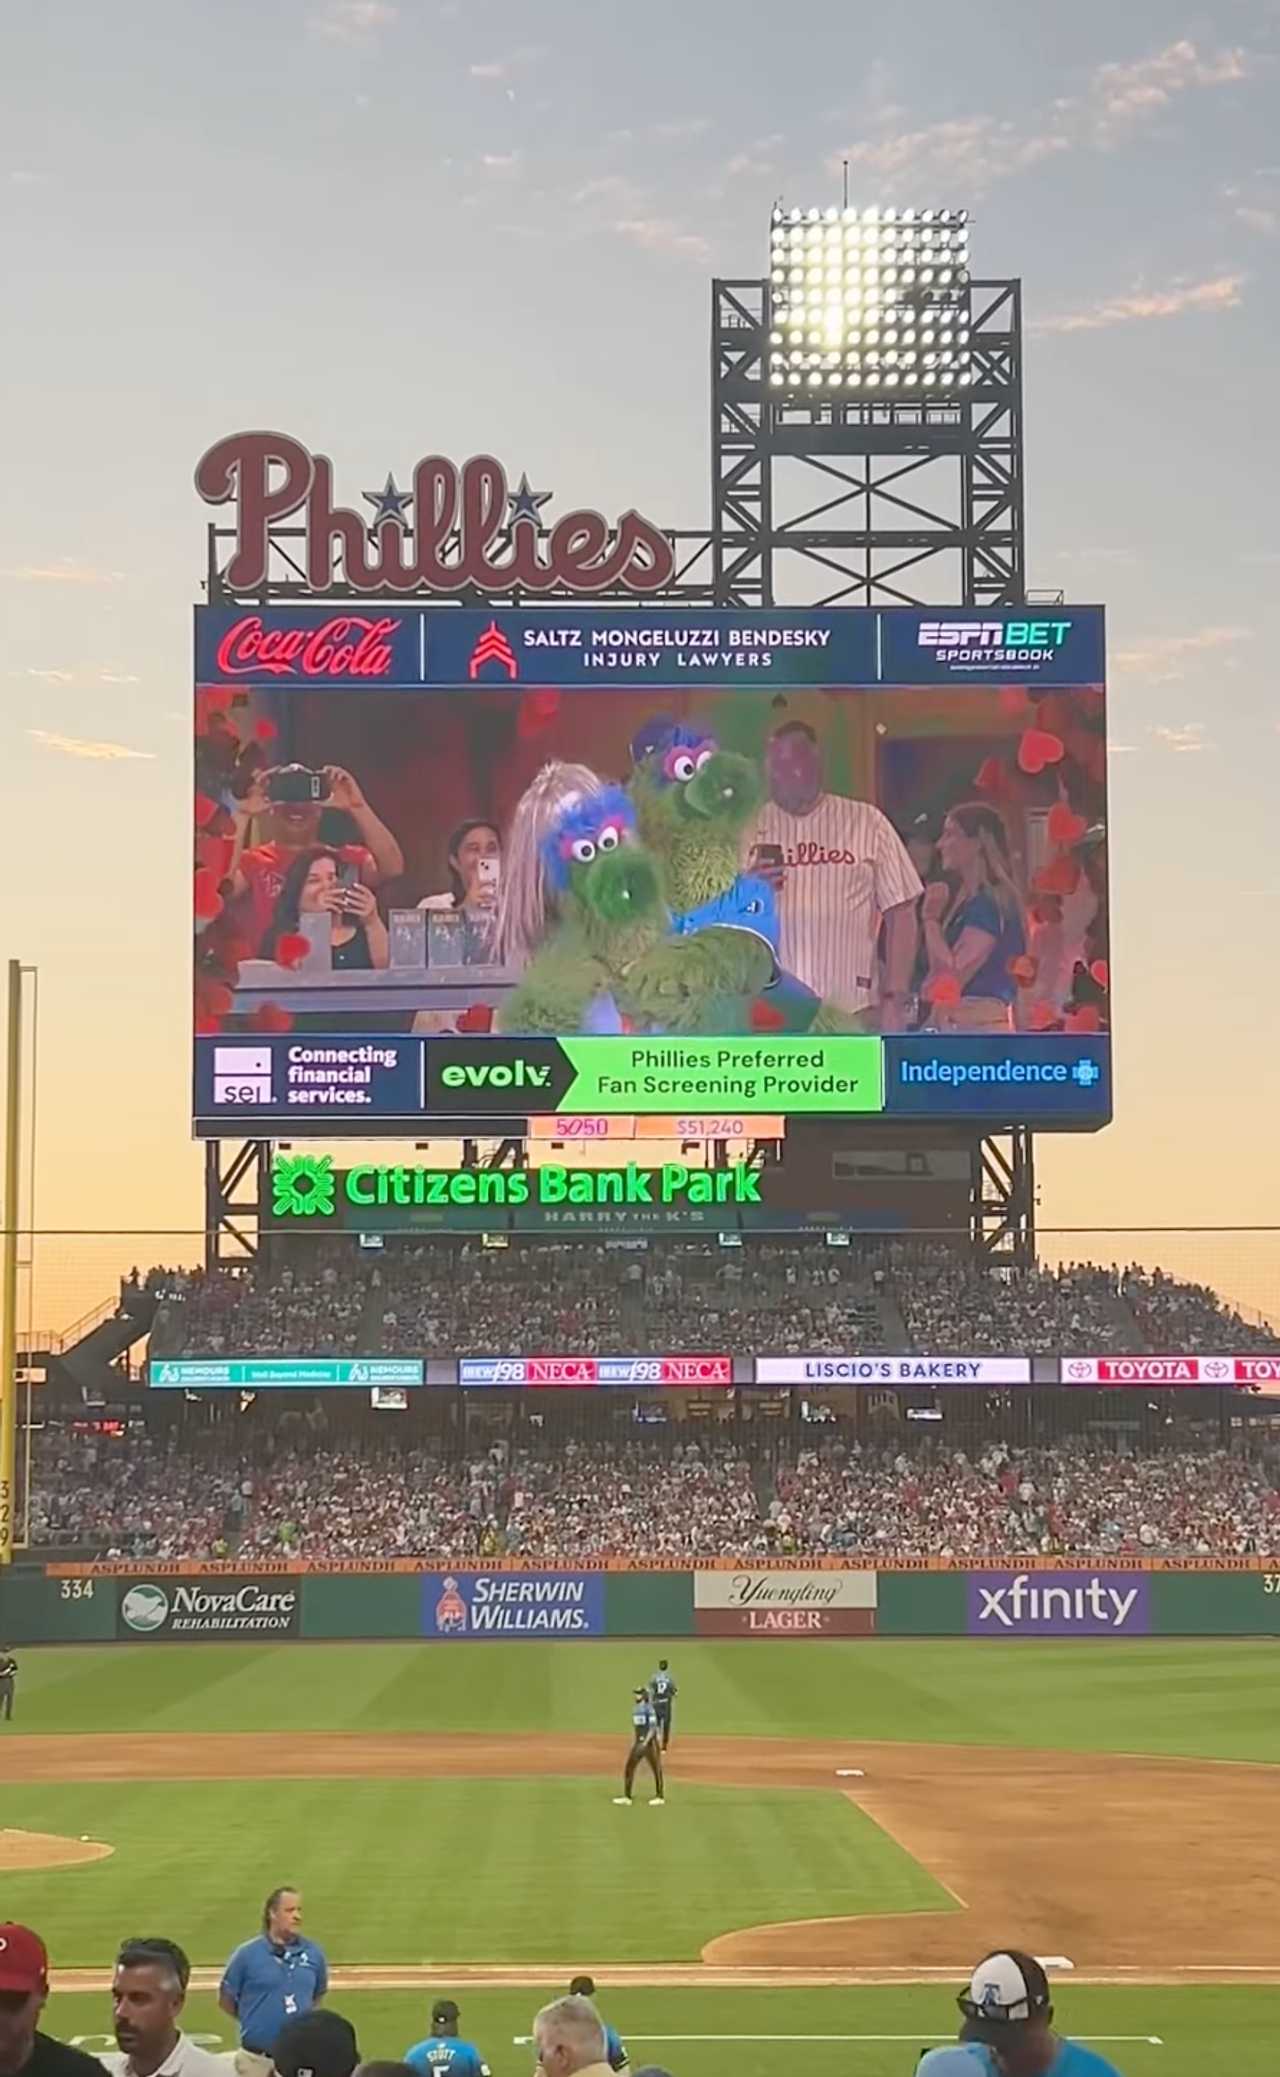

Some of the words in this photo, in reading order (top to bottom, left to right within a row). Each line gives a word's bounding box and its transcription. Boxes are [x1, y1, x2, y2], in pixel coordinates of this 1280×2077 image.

[194, 430, 675, 592] Phillies
[523, 629, 581, 647] SALTZ
[592, 629, 719, 647] MONGELUZZI
[729, 629, 831, 647] BENDESKY
[918, 622, 1003, 646] ESPN
[1005, 622, 1072, 645] BET
[217, 616, 400, 676] Coca-Cola
[584, 652, 660, 667] INJURY
[677, 652, 772, 667] LAWYERS
[936, 649, 1054, 661] SPORTSBOOK
[288, 1046, 397, 1067] Connecting
[632, 1050, 711, 1068] Phillies
[717, 1050, 824, 1068] Preferred
[288, 1066, 371, 1083] financial
[902, 1060, 1068, 1086] Independence
[288, 1086, 372, 1103] services.
[598, 1076, 637, 1094] Fan
[643, 1076, 757, 1098] Screening
[763, 1074, 858, 1093] Provider
[346, 1163, 530, 1205] Citizens
[540, 1161, 652, 1205] Bank
[662, 1162, 763, 1204] Park
[544, 1211, 627, 1222] HARRY
[531, 1362, 593, 1381] NECA
[667, 1362, 728, 1381] NECA
[806, 1363, 891, 1378] LISCIO'S
[900, 1362, 981, 1377] BAKERY
[1105, 1361, 1191, 1379] TOYOTA
[91, 1564, 180, 1574] ASPLUNDH
[200, 1564, 288, 1573] ASPLUNDH
[307, 1562, 395, 1571] ASPLUNDH
[414, 1562, 501, 1571] ASPLUNDH
[521, 1561, 609, 1570] ASPLUNDH
[628, 1560, 715, 1569] ASPLUNDH
[734, 1560, 822, 1569] ASPLUNDH
[840, 1560, 929, 1569] ASPLUNDH
[948, 1560, 1036, 1569] ASPLUNDH
[1054, 1560, 1142, 1569] ASPLUNDH
[1161, 1560, 1249, 1569] ASPLUNDH
[61, 1580, 94, 1599] 334
[473, 1578, 584, 1602] SHERWIN
[728, 1575, 843, 1606] Yuengling
[171, 1587, 295, 1613] NovaCare
[979, 1575, 1138, 1626] xfinity
[172, 1617, 291, 1629] REHABILITATION
[750, 1611, 822, 1629] LAGER
